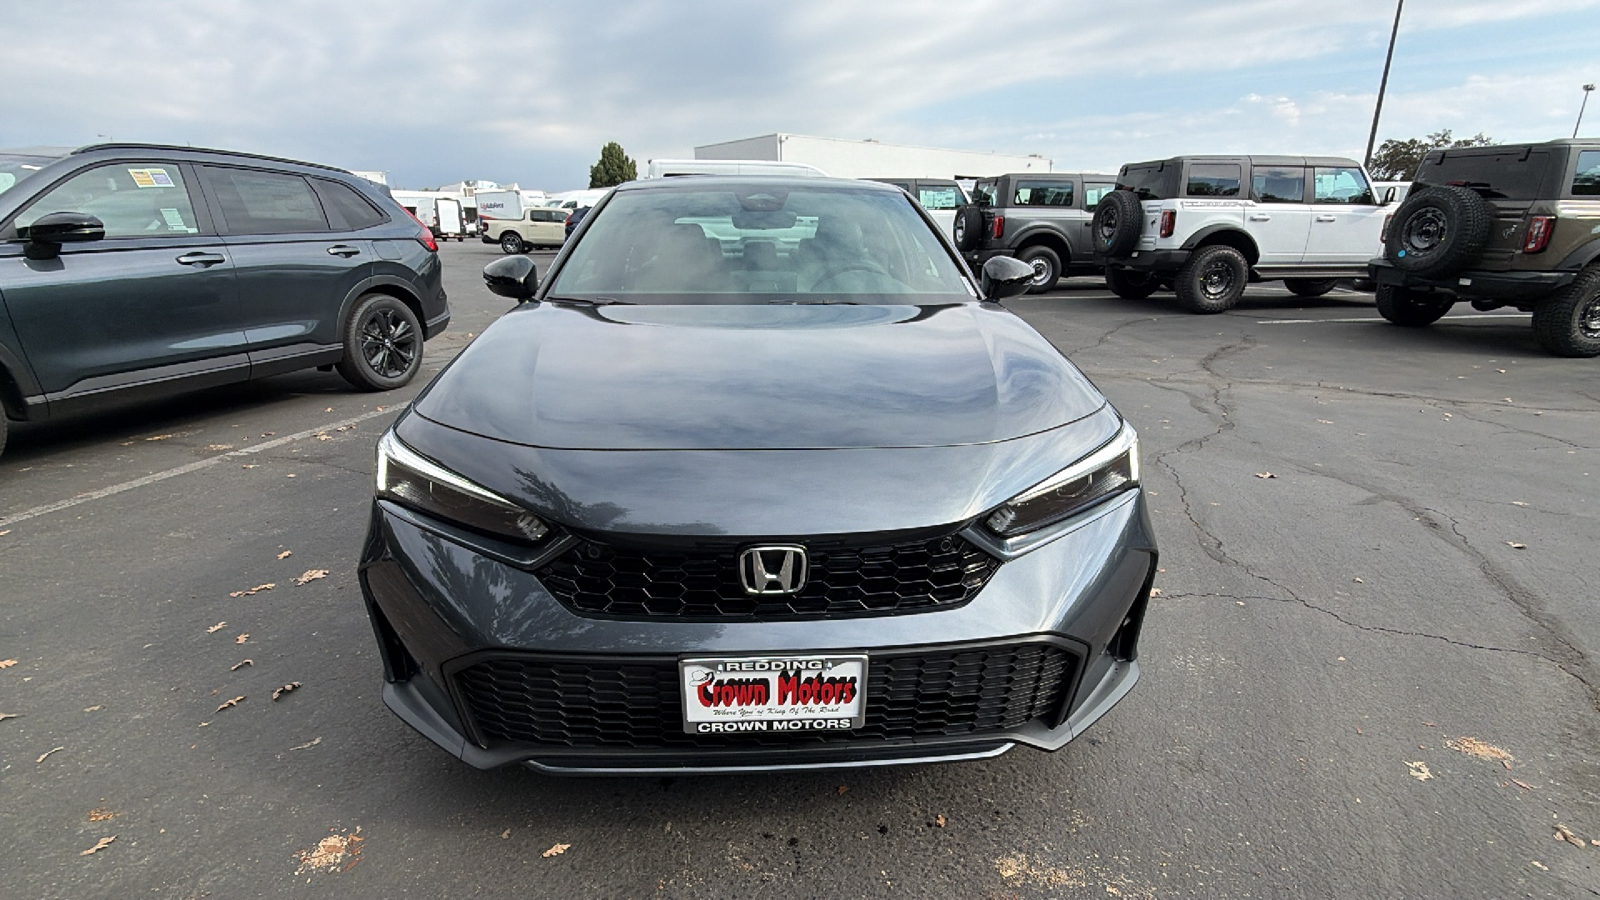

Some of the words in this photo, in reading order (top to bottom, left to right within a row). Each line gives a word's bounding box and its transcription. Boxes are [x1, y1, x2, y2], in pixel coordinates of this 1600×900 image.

[726, 661, 823, 671] REDDING
[697, 675, 770, 708] Crown
[778, 671, 857, 706] Motors
[767, 708, 786, 717] King
[788, 707, 799, 716] Of
[801, 706, 816, 714] The
[698, 721, 767, 733] CROWN
[773, 719, 851, 731] MOTORS
